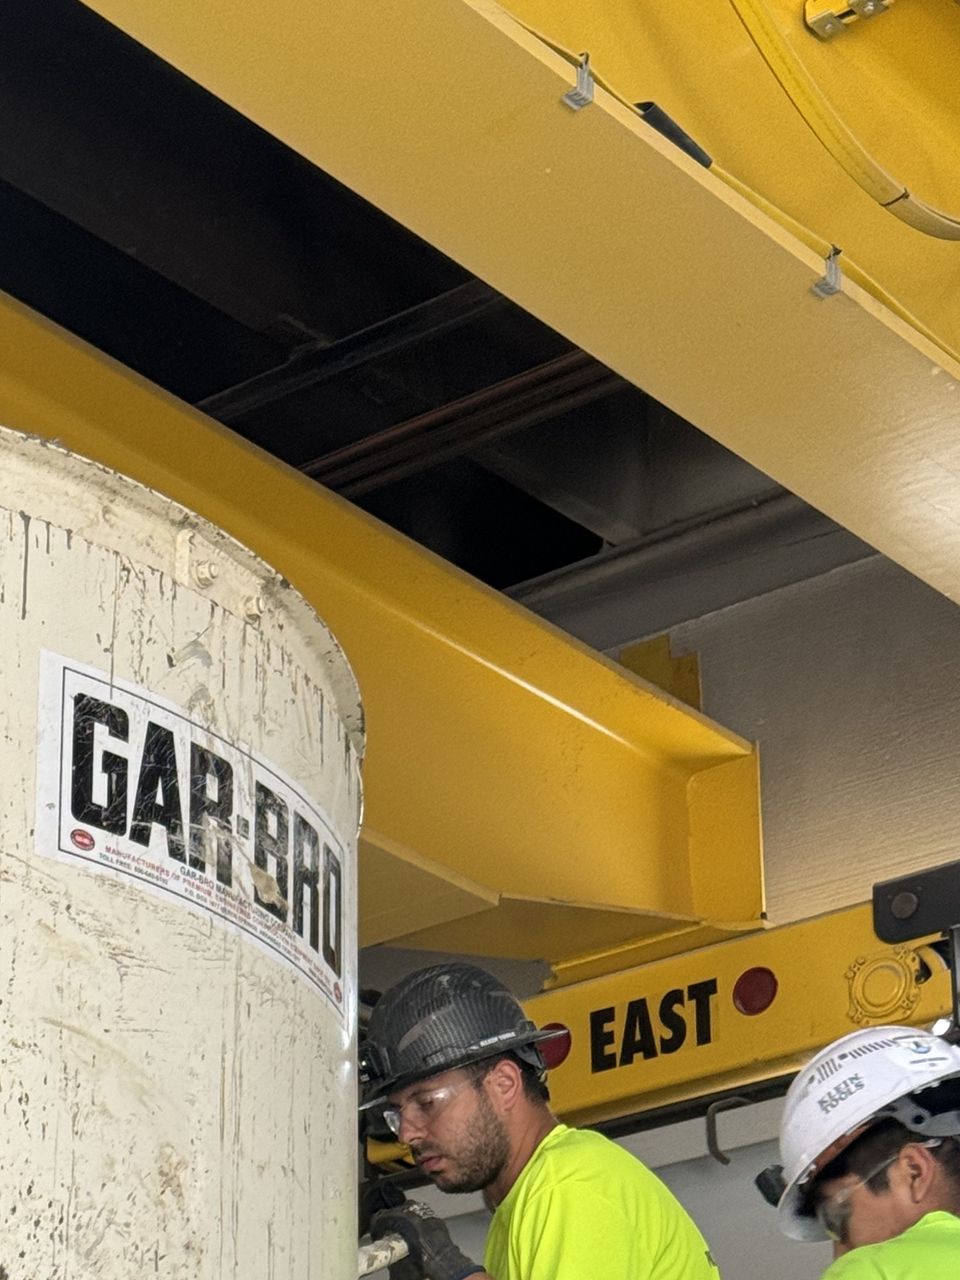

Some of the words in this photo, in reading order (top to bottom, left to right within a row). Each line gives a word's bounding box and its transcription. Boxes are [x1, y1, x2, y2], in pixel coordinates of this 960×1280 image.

[70, 692, 343, 980] GAR-BRO
[589, 977, 718, 1074] EAST
[822, 1081, 865, 1114] TOOLS
